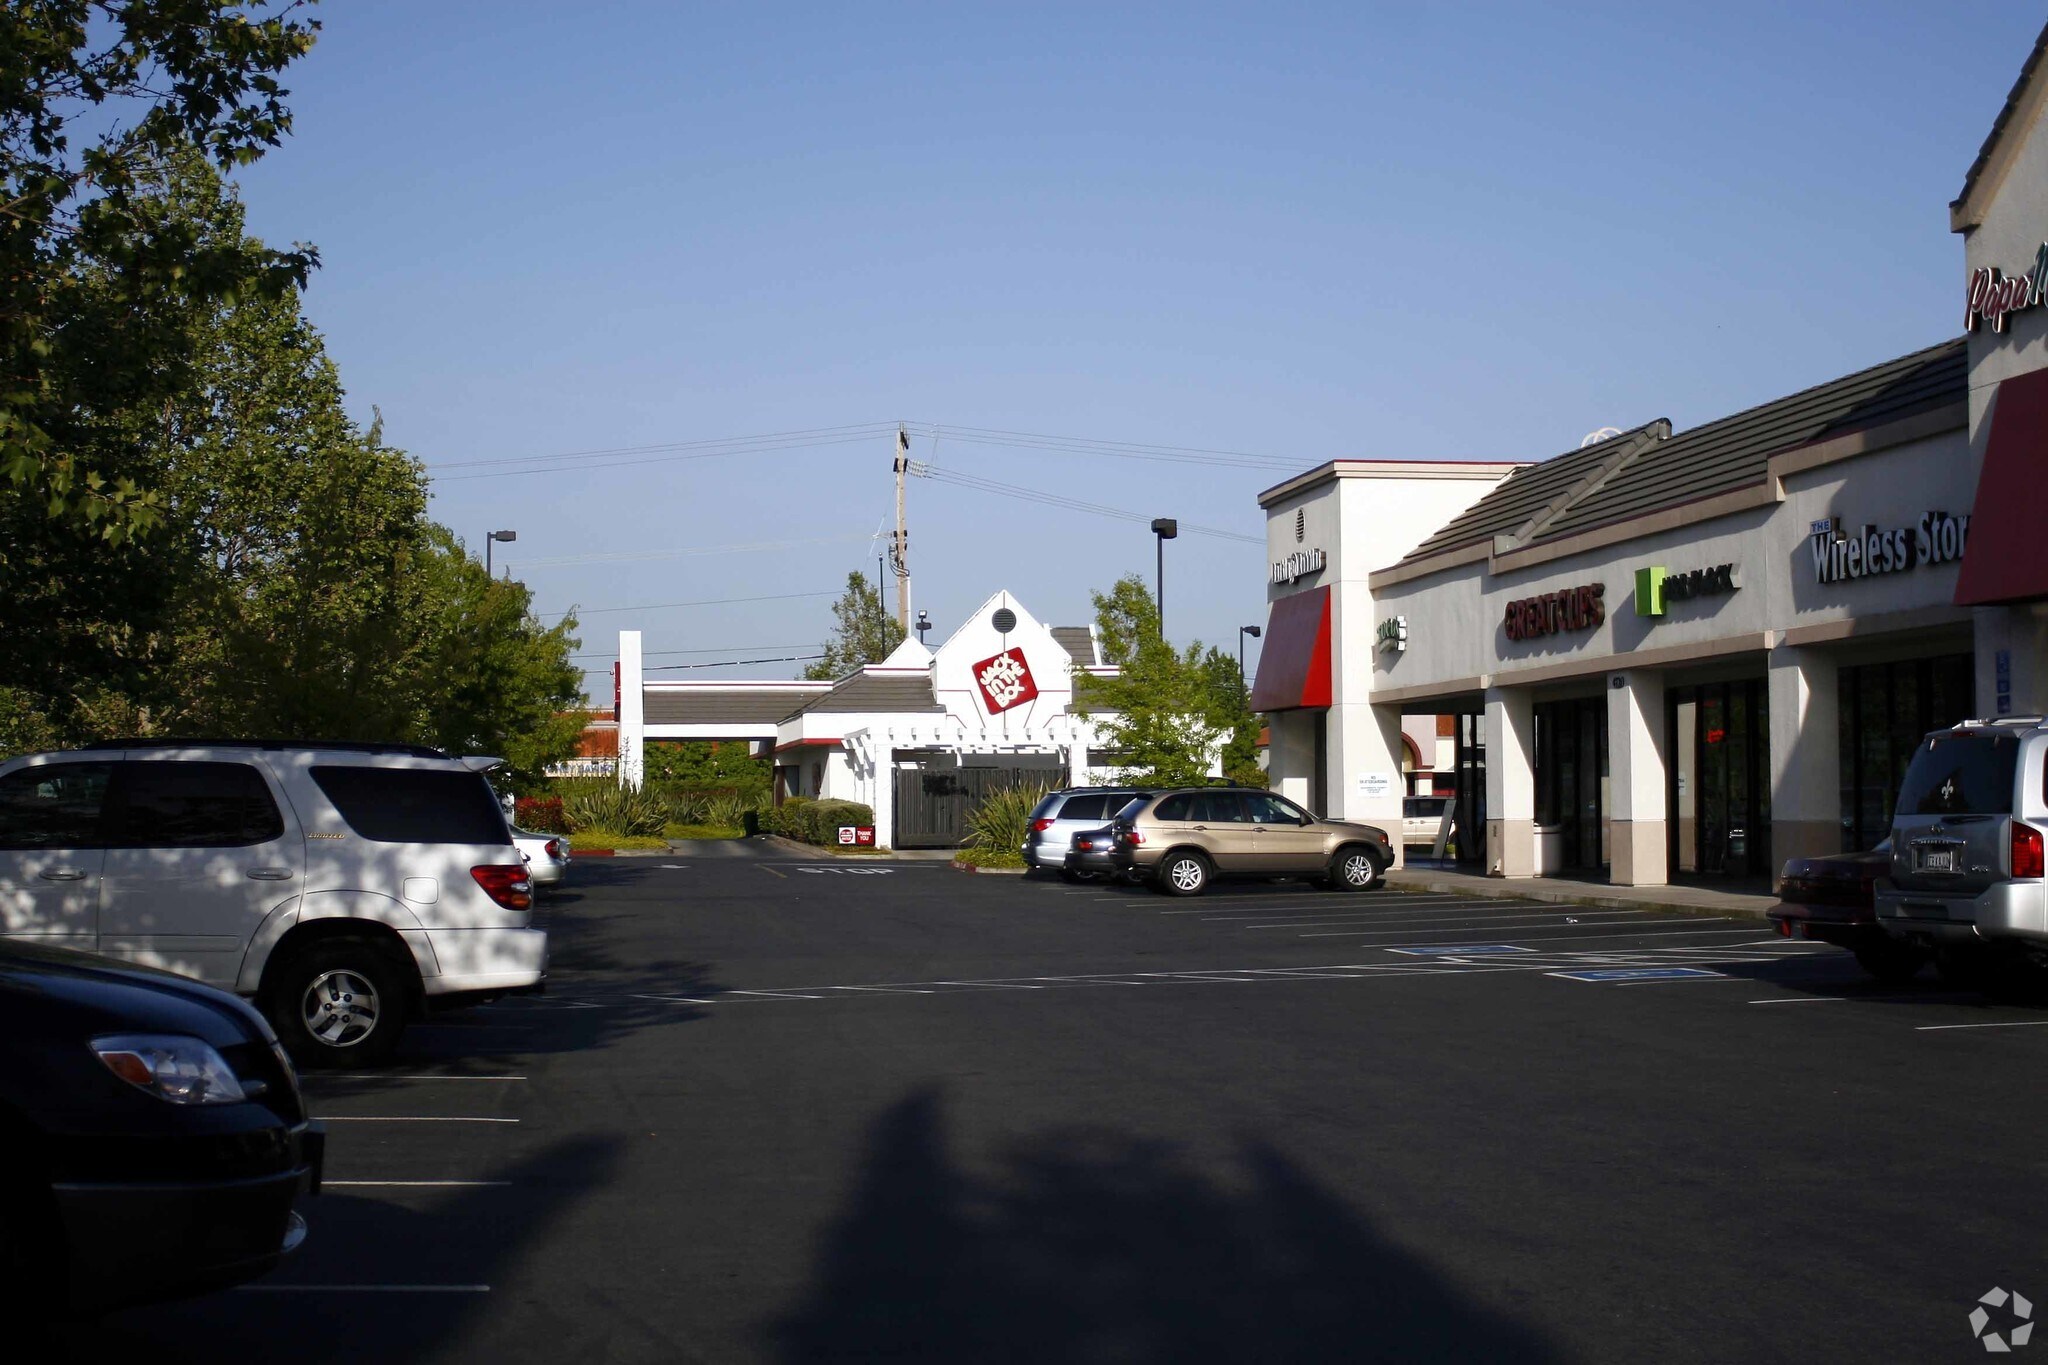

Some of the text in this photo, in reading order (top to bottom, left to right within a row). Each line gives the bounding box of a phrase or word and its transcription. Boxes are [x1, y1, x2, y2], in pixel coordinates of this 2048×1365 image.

[1964, 267, 2031, 333] Papa
[1811, 520, 1830, 532] THE
[1811, 511, 1968, 583] Wireless Stor
[1504, 582, 1605, 640] GREAT CLIPS
[980, 652, 1014, 685] JACK
[985, 661, 1025, 697] IN THE
[994, 679, 1025, 708] BOX
